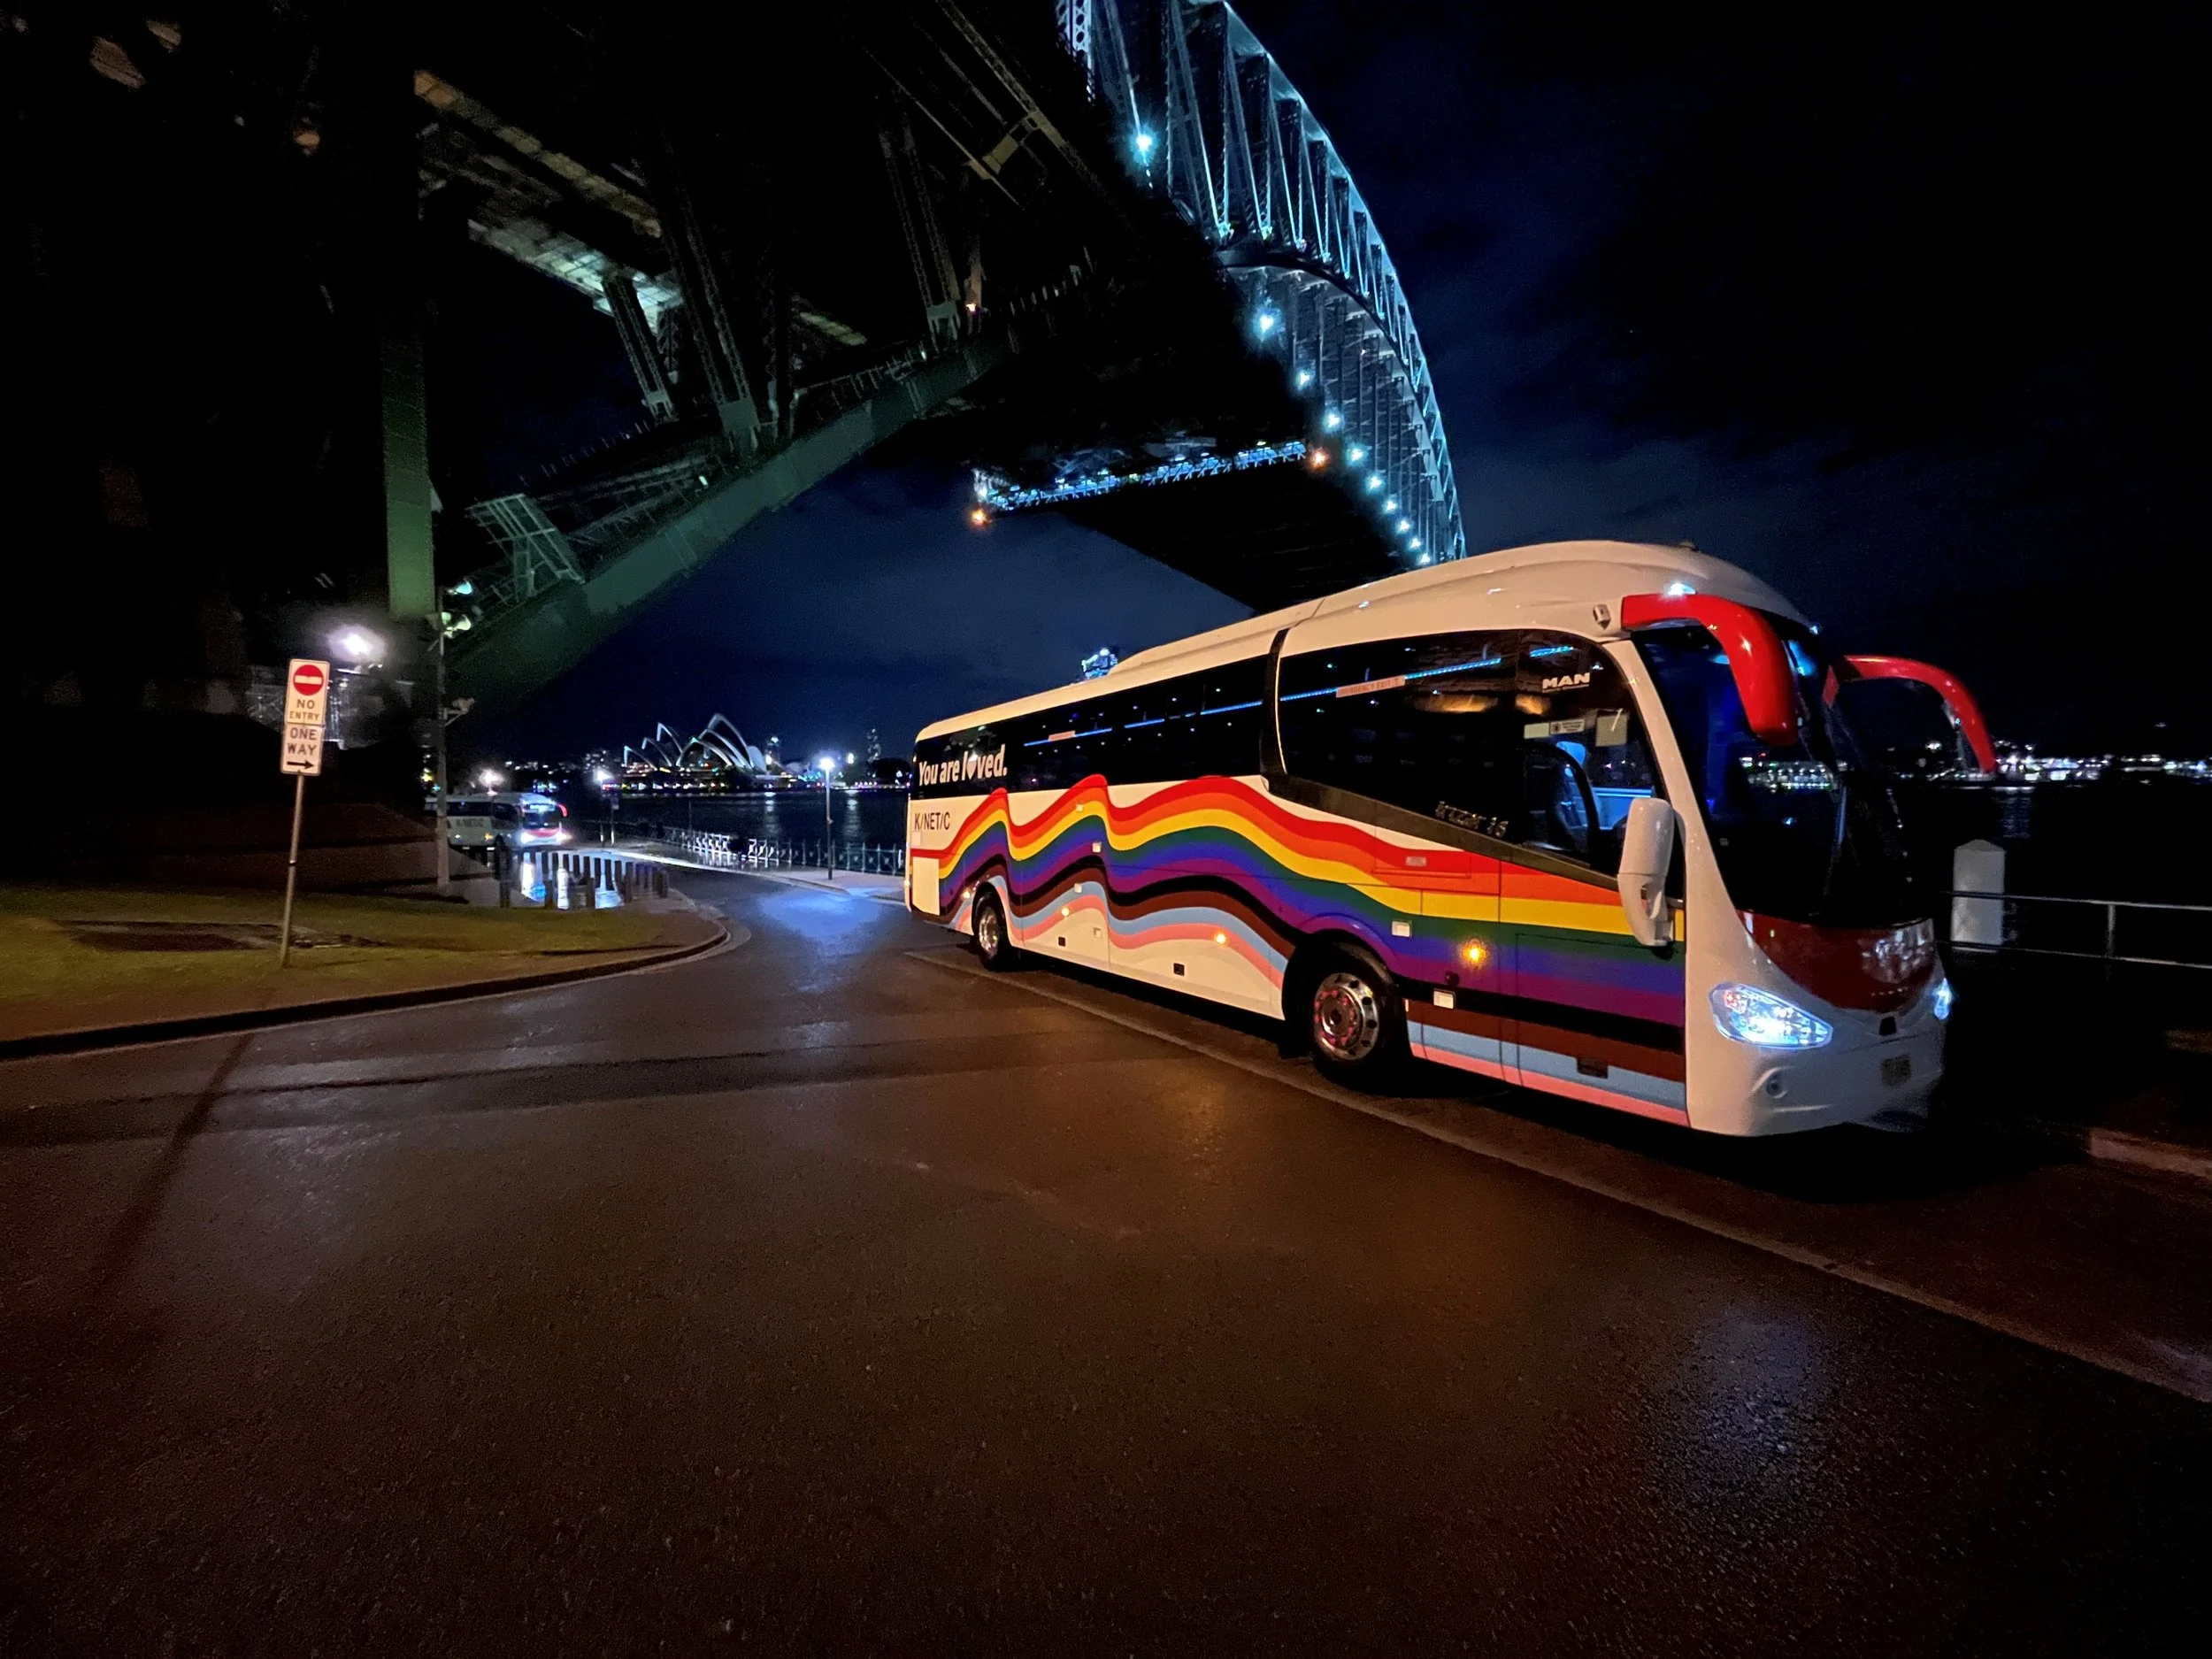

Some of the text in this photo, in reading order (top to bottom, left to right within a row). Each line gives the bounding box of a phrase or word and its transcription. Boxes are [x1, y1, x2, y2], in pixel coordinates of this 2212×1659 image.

[1542, 672, 1590, 689] MAN
[296, 699, 315, 710] NO
[289, 710, 320, 720] ENTRY
[290, 727, 317, 741] ONE
[287, 743, 317, 756] WAY
[919, 761, 939, 786] You
[939, 760, 960, 783] are
